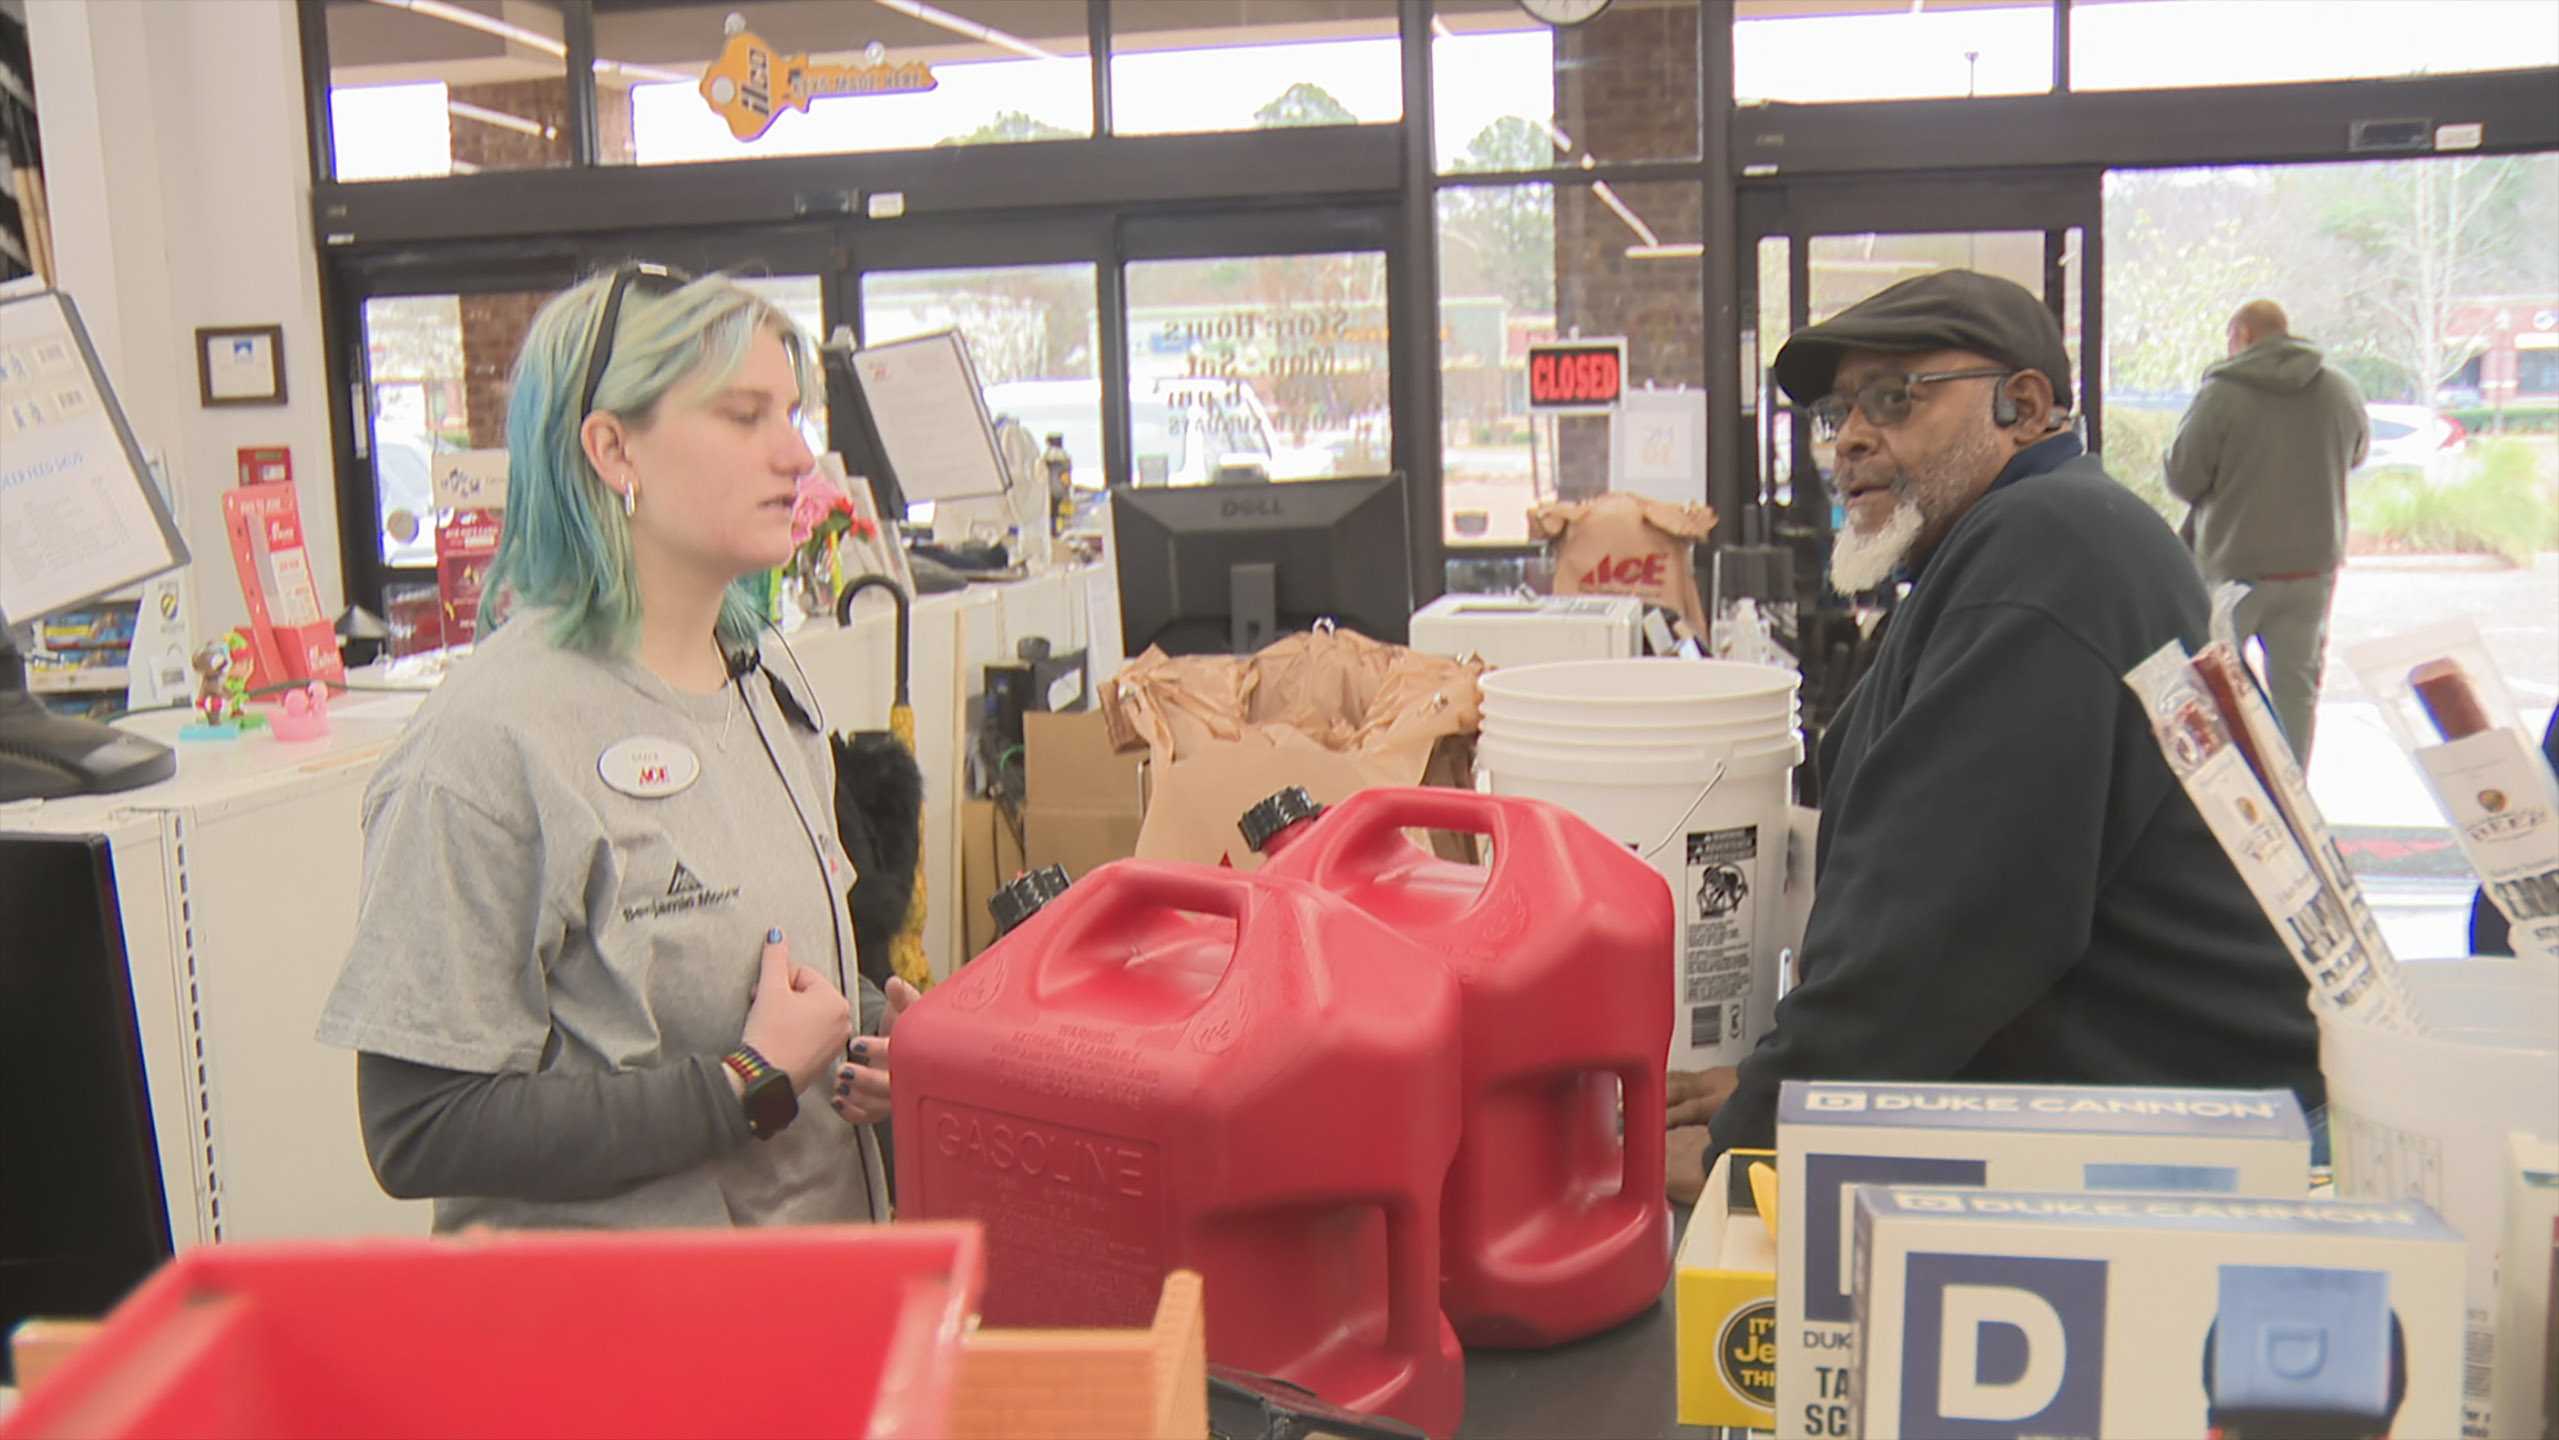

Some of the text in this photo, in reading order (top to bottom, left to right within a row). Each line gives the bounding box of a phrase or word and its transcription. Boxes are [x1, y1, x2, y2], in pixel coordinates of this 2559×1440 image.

[1532, 353, 1620, 400] CLOSED
[1220, 498, 1284, 518] DELL
[1579, 552, 1670, 587] ACE
[623, 898, 695, 922] Benjamin
[1874, 1093, 2019, 1113] DUKE
[2028, 1095, 2276, 1119] CANNON
[937, 1111, 1143, 1197] GASOLINE
[1971, 1199, 2124, 1218] DUKE
[2138, 1204, 2417, 1228] CANNON
[1938, 1284, 2066, 1422] D
